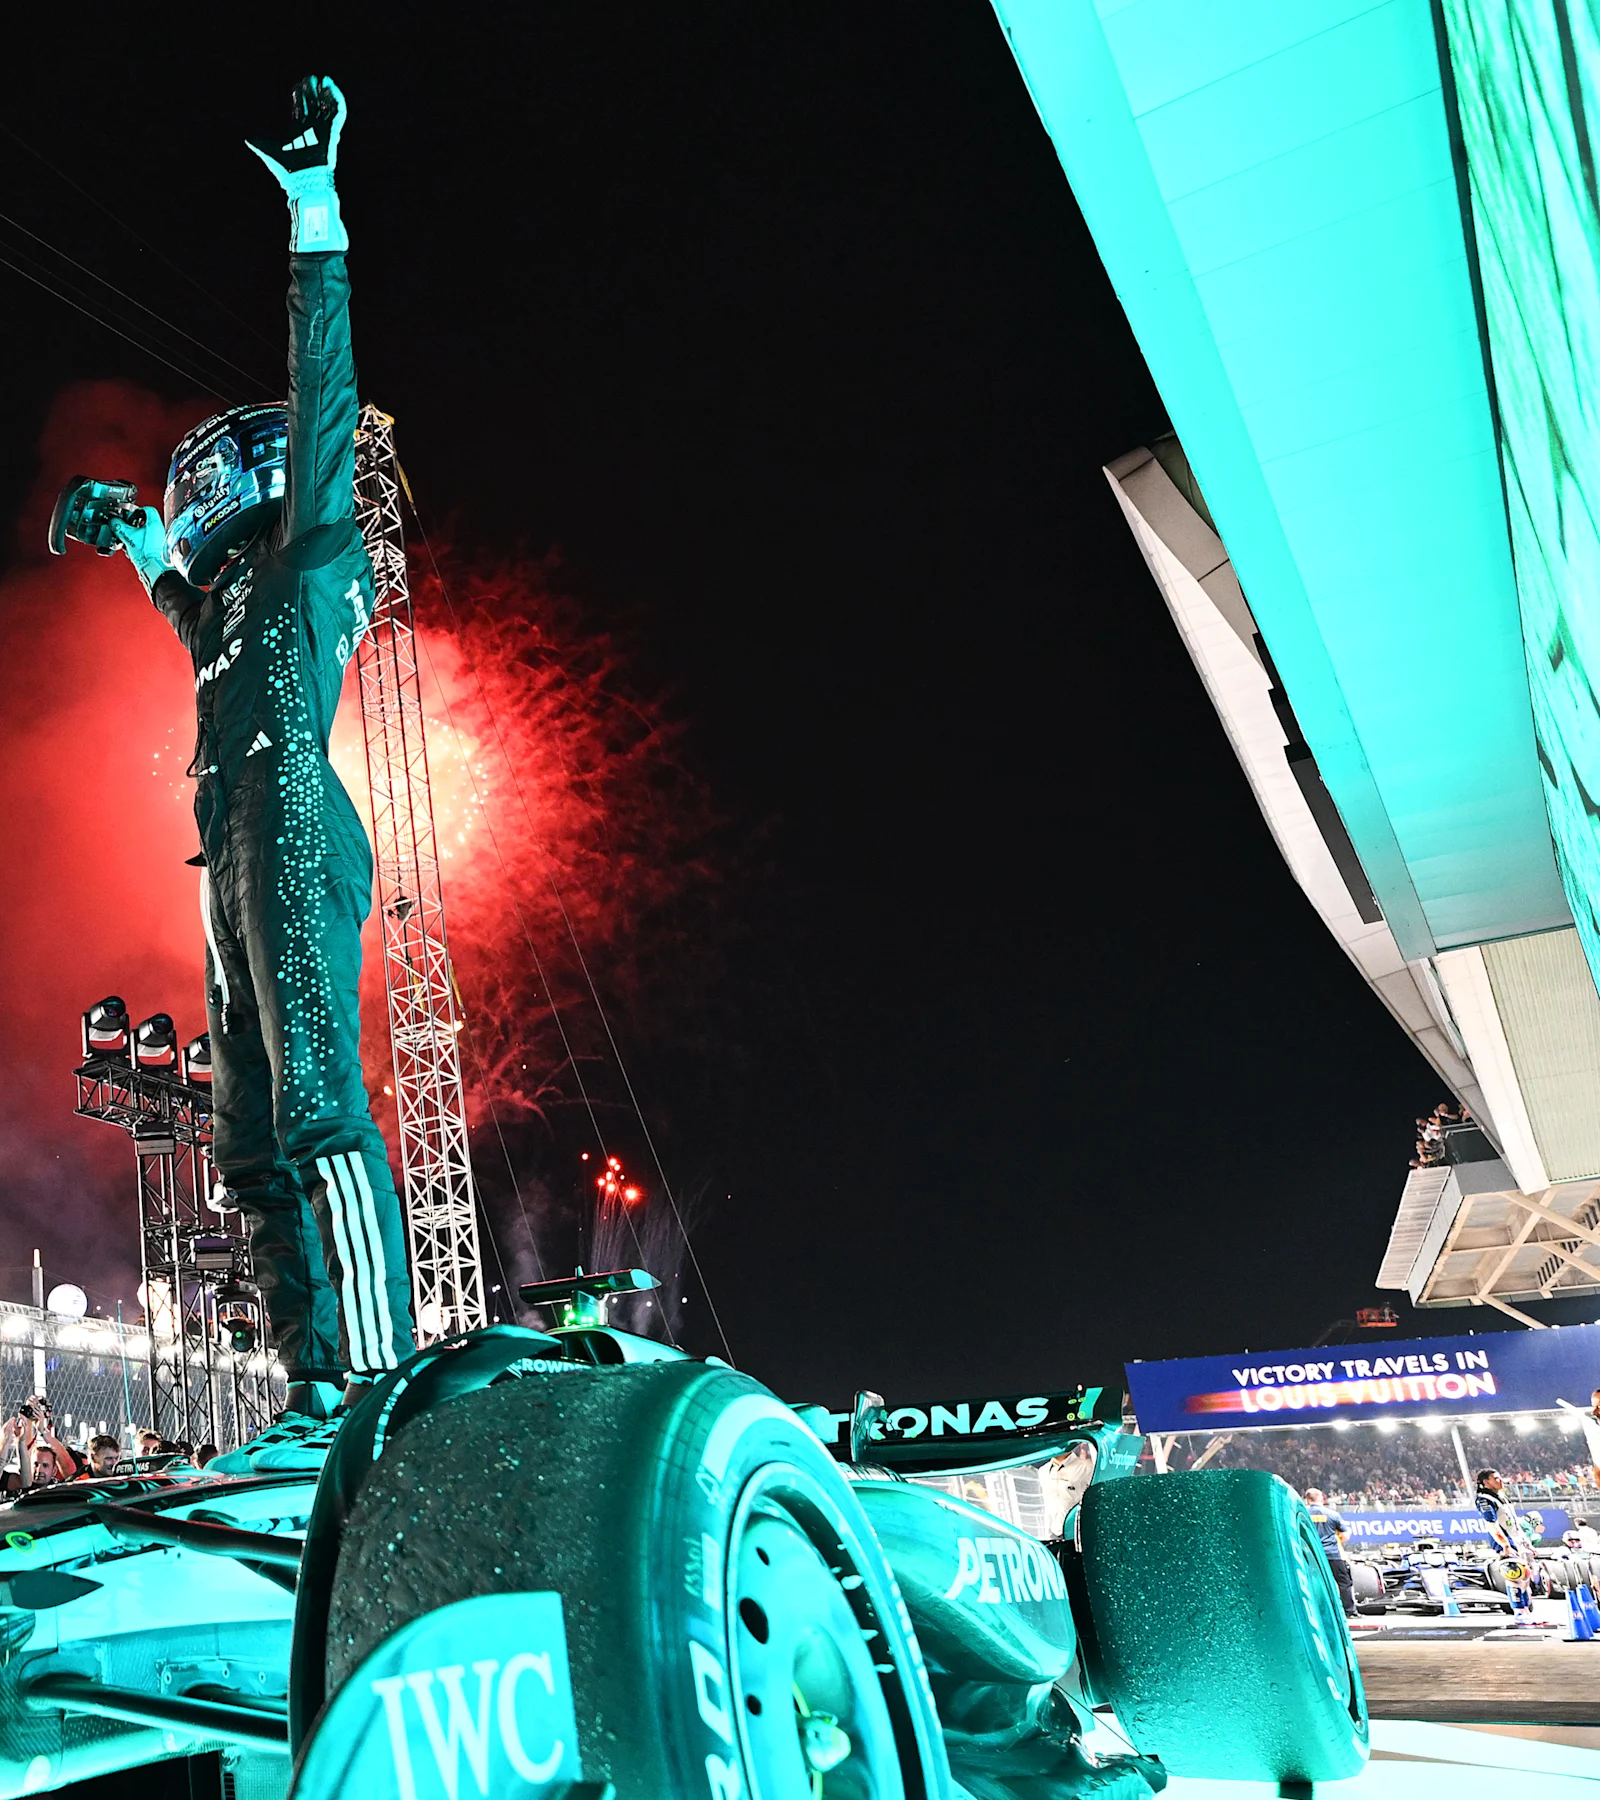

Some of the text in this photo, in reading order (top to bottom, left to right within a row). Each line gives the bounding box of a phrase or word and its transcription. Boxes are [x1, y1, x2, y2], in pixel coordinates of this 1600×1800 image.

[178, 424, 231, 468] CROWDSTRIKE
[1231, 1349, 1490, 1387] VICTORY TRAVELS IN
[1238, 1370, 1497, 1414] LOUIS VUITTON
[115, 1461, 150, 1474] PETRNAS
[1345, 1519, 1445, 1537] SINGAPORE
[943, 1536, 1070, 1604] PETRONA
[370, 1650, 565, 1800] IWC
